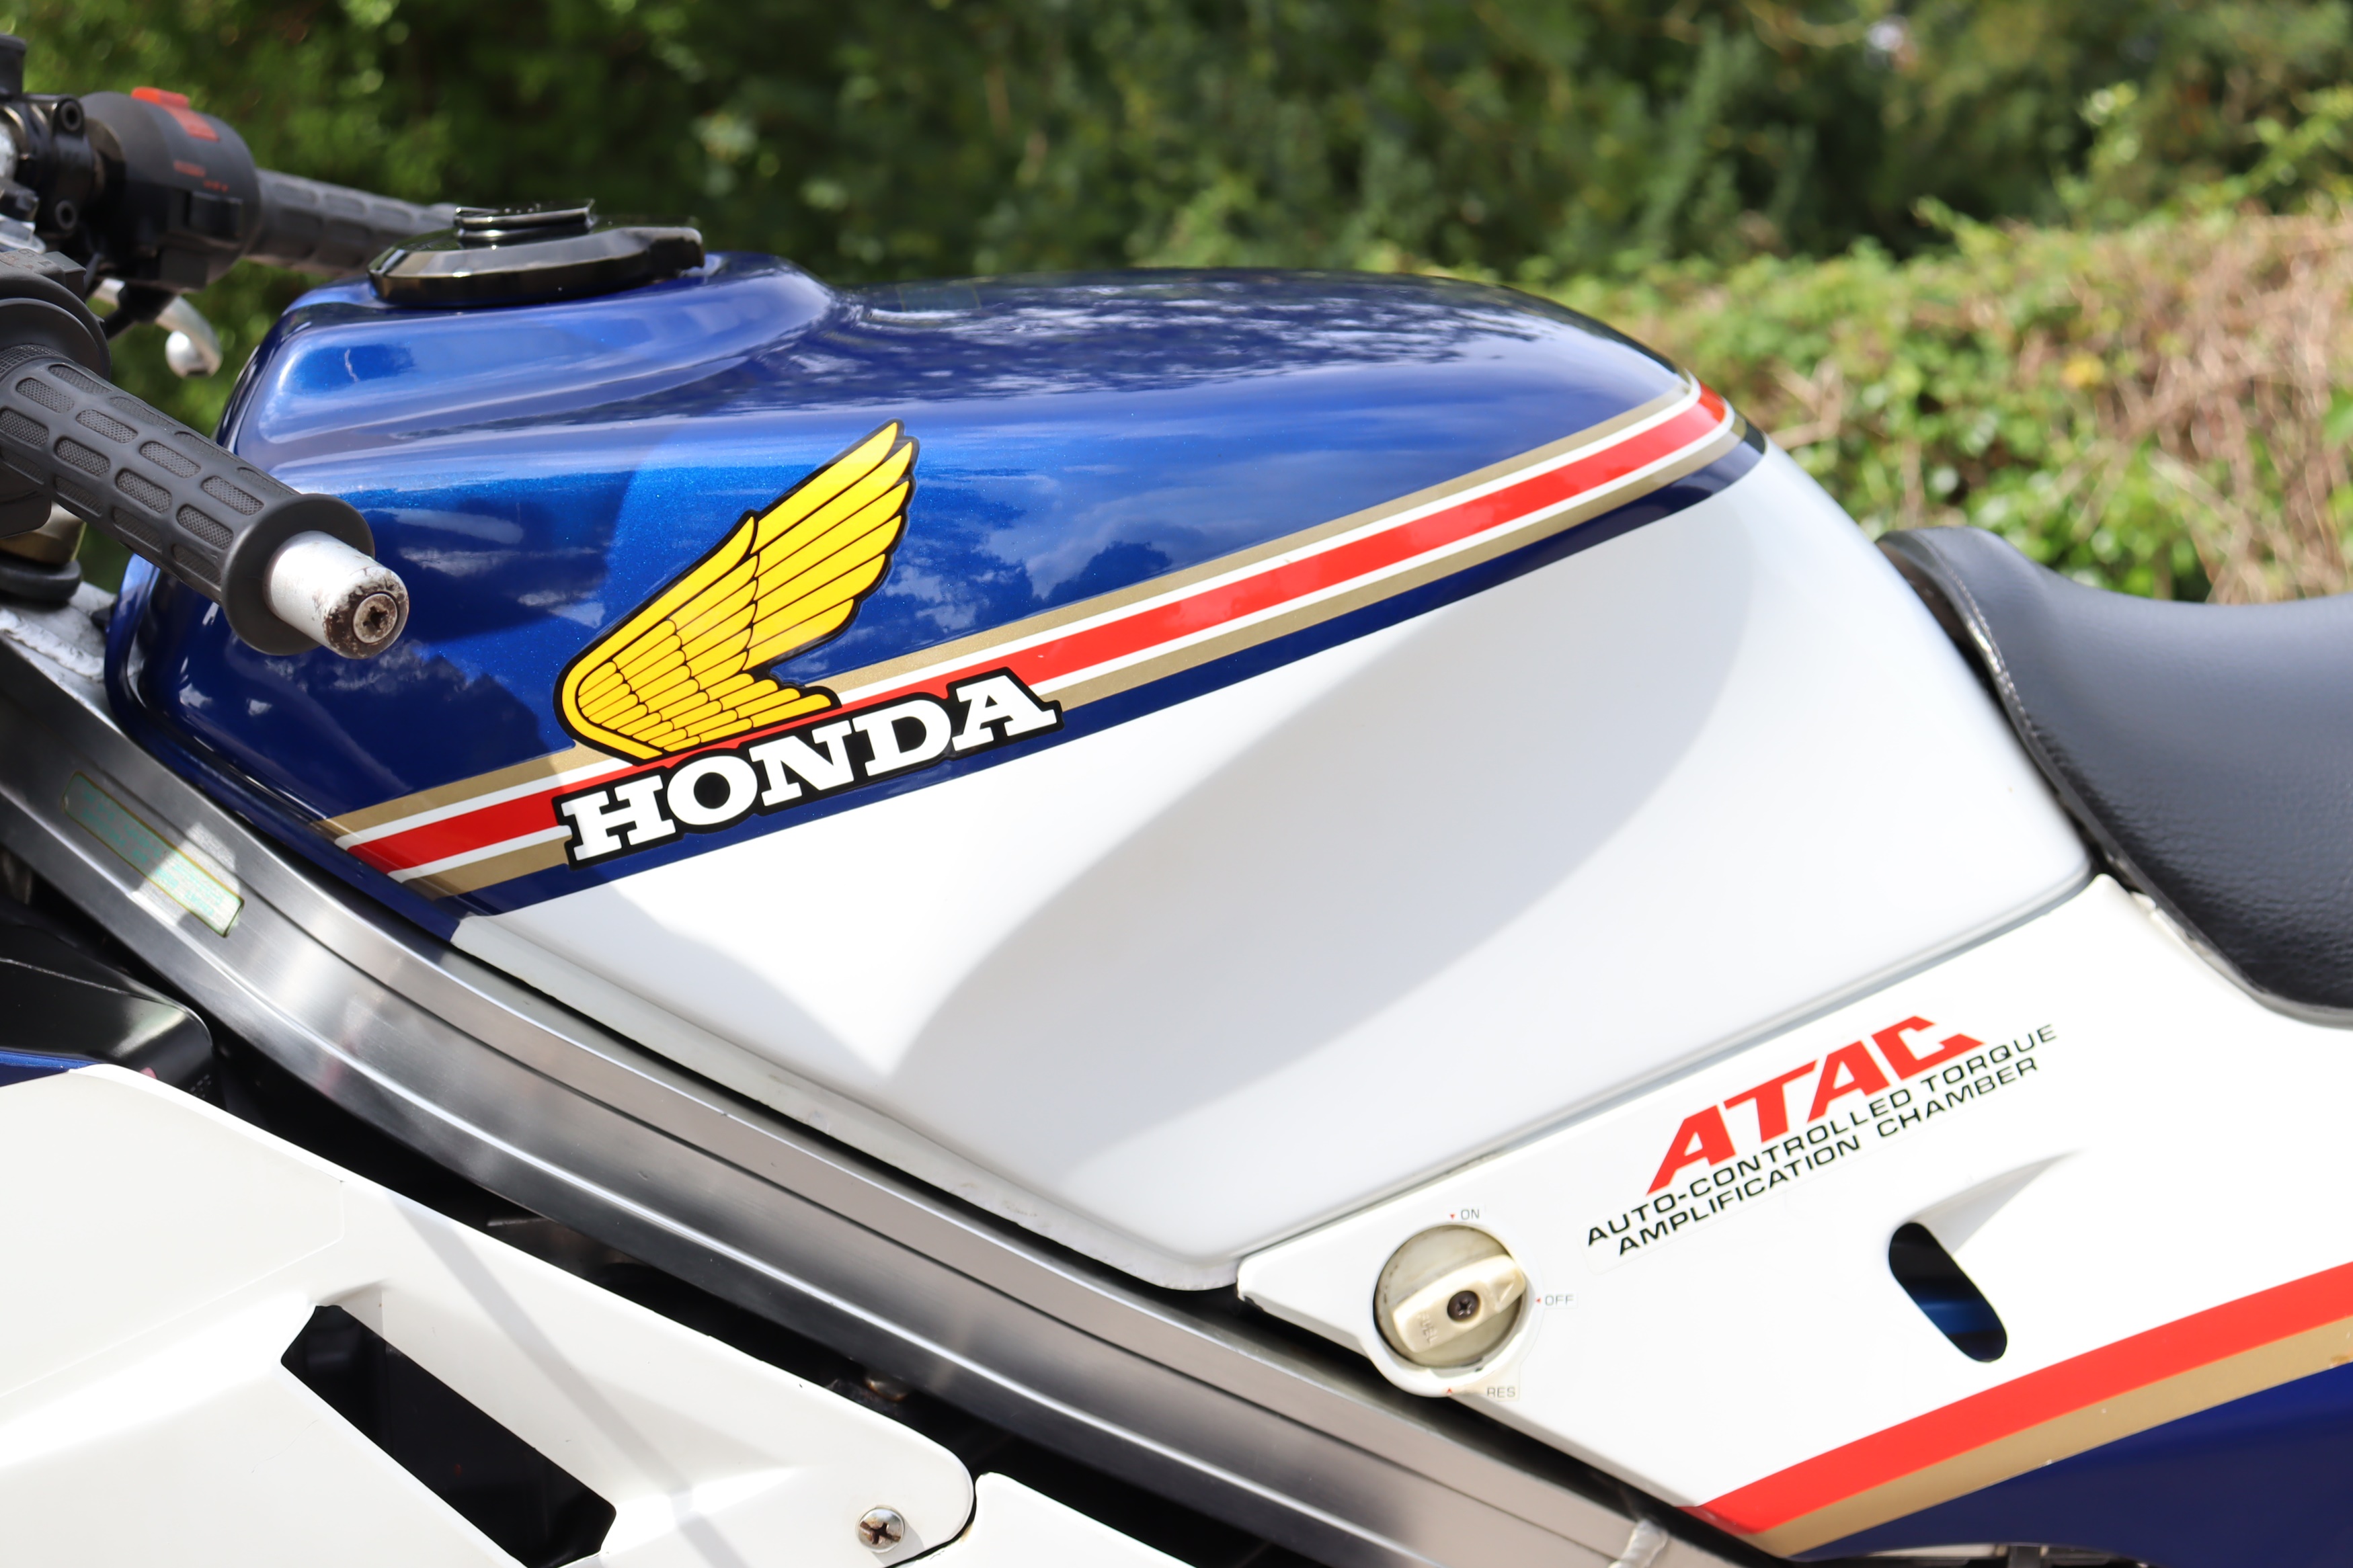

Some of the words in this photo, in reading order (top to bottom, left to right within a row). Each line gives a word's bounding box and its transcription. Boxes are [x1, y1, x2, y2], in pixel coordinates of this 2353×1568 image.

[561, 675, 1058, 861] HONDA
[1587, 1087, 1912, 1246] AUTO-CONTROLLED
[1920, 1024, 2058, 1091] TORQUE
[1618, 1135, 1860, 1256] AMPLIFICATION
[1876, 1057, 2039, 1139] CHAMBER
[1646, 1016, 1985, 1195] ATAC
[1460, 1209, 1480, 1220] ON
[1544, 1295, 1574, 1306] OFF
[1486, 1387, 1516, 1398] RES
